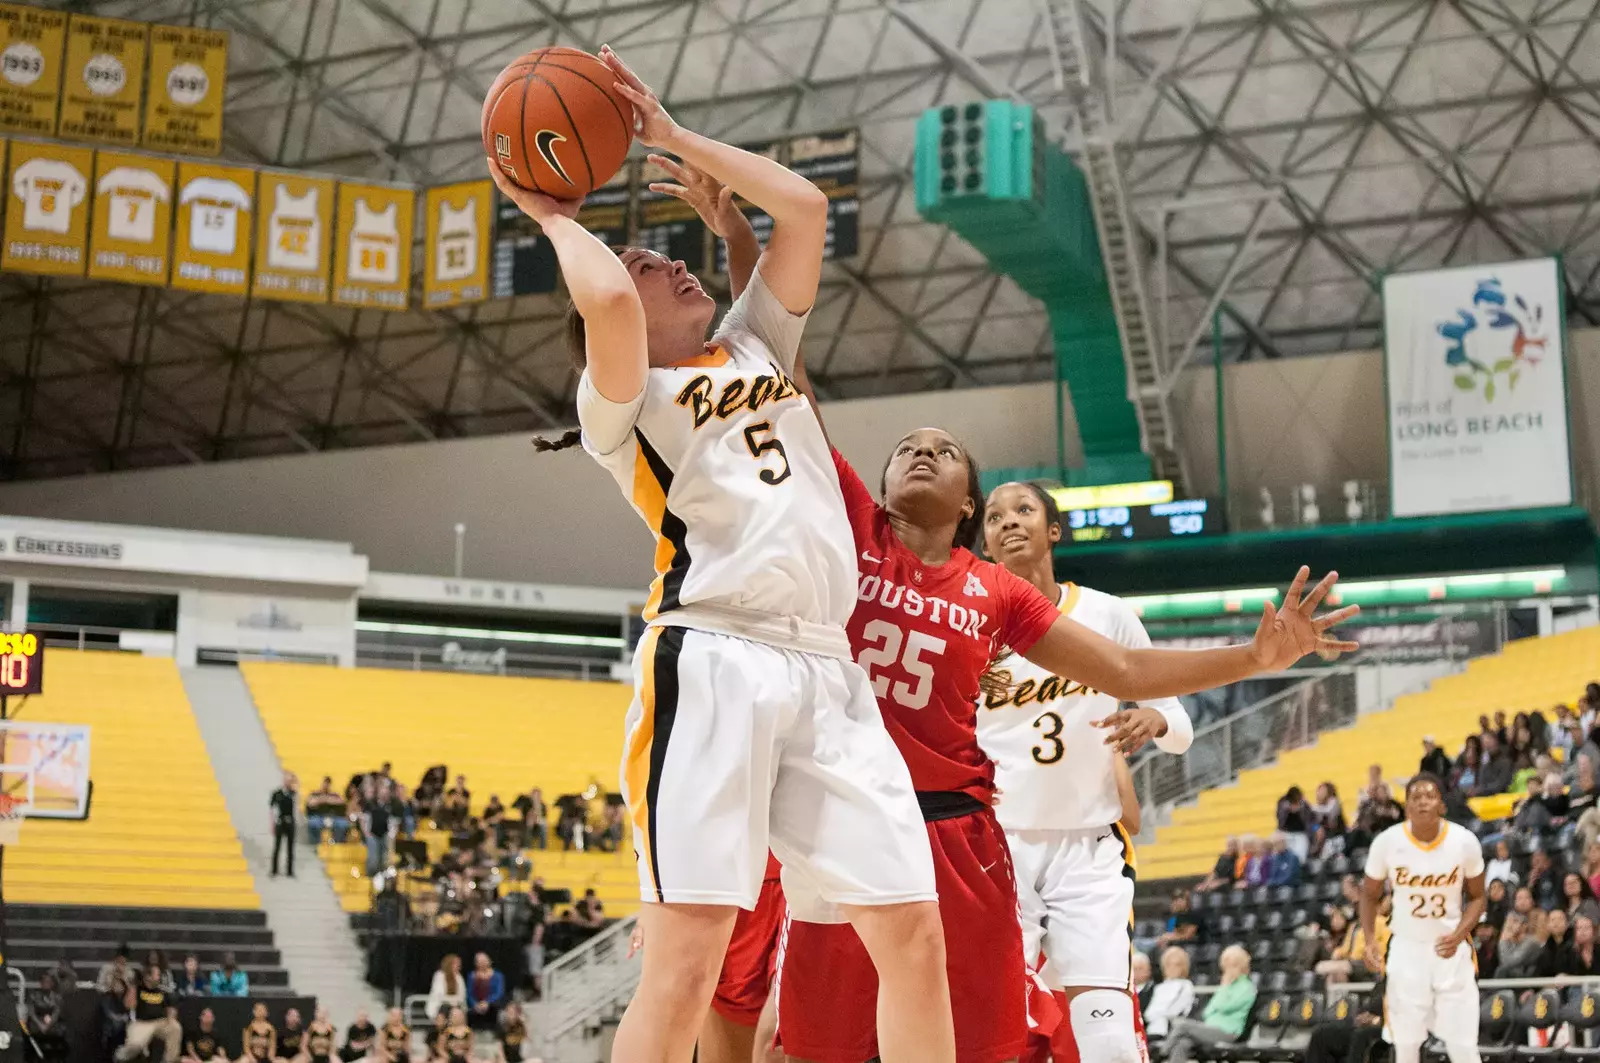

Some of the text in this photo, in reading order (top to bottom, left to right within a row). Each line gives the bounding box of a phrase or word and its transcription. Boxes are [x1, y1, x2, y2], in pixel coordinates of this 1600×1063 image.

[1396, 411, 1543, 441] LONG BEACH
[743, 419, 793, 486] 5
[1169, 514, 1203, 535] 50
[15, 536, 124, 560] CONCESSIONS
[858, 571, 989, 641] OUSTON
[857, 617, 948, 711] 25
[1031, 711, 1065, 765] 3
[1394, 864, 1460, 887] Beach
[1408, 892, 1448, 919] 23
